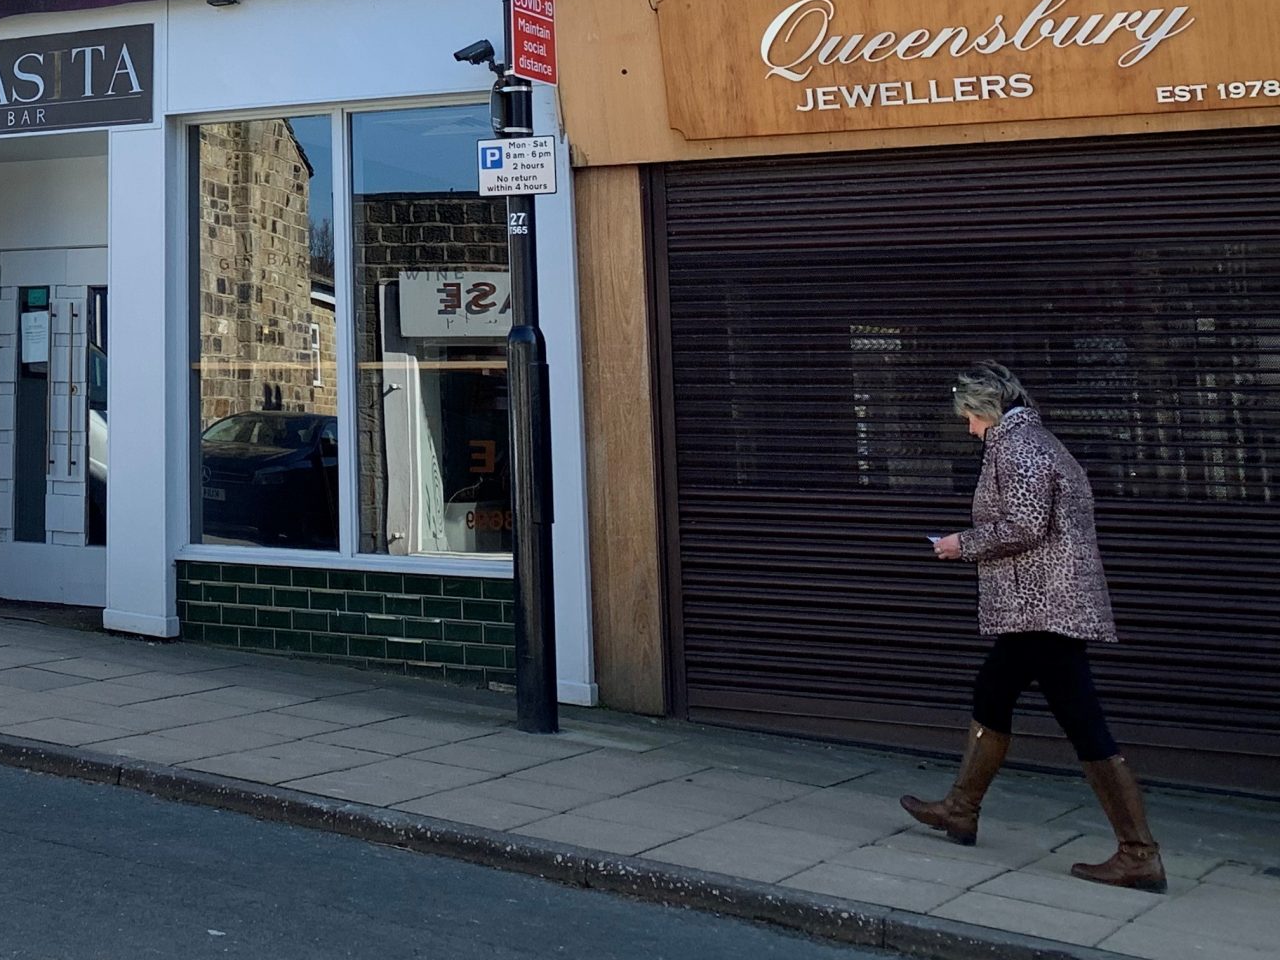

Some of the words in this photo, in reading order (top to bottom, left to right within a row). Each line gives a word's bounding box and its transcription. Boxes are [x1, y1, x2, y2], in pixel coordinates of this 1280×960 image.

[517, 16, 551, 40] Maintain
[523, 40, 547, 57] social
[518, 55, 552, 76] distance
[796, 73, 1034, 112] JEWELLERS
[1156, 83, 1208, 104] EST
[1216, 79, 1280, 101] 1978
[7, 108, 47, 127] BAR
[508, 141, 527, 149] Mon
[532, 140, 548, 148] Sat
[486, 149, 500, 168] P
[531, 150, 537, 158] 6
[538, 151, 552, 159] pm
[512, 162, 519, 170] 2
[520, 161, 545, 170] hours
[496, 175, 509, 183] No
[511, 174, 538, 182] return
[486, 184, 513, 192] within
[515, 183, 521, 191] 4
[523, 183, 548, 191] hours
[509, 212, 526, 226] 27
[267, 252, 307, 269] BAR
[404, 267, 465, 281] WINE
